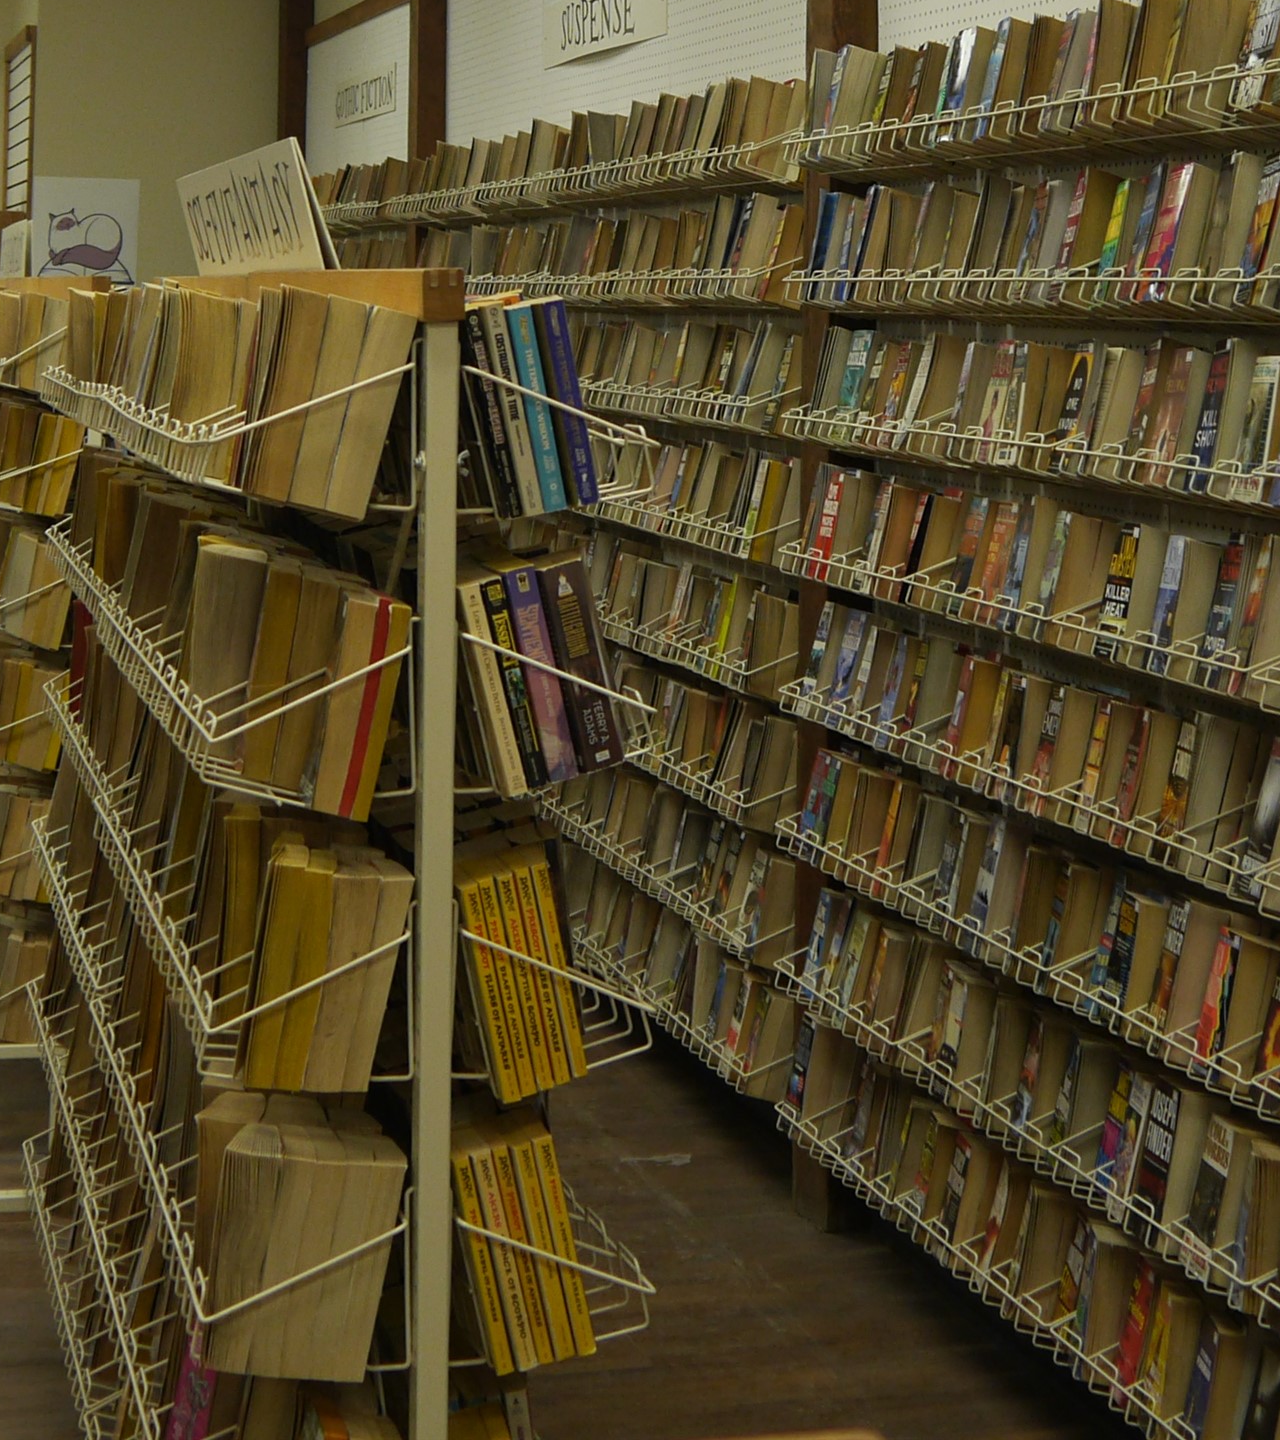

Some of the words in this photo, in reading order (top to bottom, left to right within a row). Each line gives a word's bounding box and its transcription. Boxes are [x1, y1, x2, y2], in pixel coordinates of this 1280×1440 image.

[335, 85, 360, 120] GOTHIC
[360, 71, 394, 112] FICTION
[505, 397, 520, 422] TIME
[1202, 411, 1218, 427] KILL
[1195, 428, 1218, 447] SHOT
[1104, 600, 1128, 619] HEAT
[1105, 584, 1130, 603] KILLER
[557, 594, 590, 659] BATTLEGROUND
[582, 708, 598, 746] ADAMS
[592, 699, 608, 728] TERRY
[527, 908, 541, 952] PRESCOT
[492, 1009, 500, 1022] OF
[543, 990, 551, 1005] OF
[494, 1023, 512, 1071] ANTARES
[510, 1017, 525, 1060] ANTARES
[528, 1005, 540, 1047] SCORPIO
[546, 1007, 562, 1053] ANTARES
[1150, 1086, 1179, 1128] JOSEPH
[1146, 1121, 1174, 1164] FINDER
[511, 1296, 527, 1340] SCORPIO
